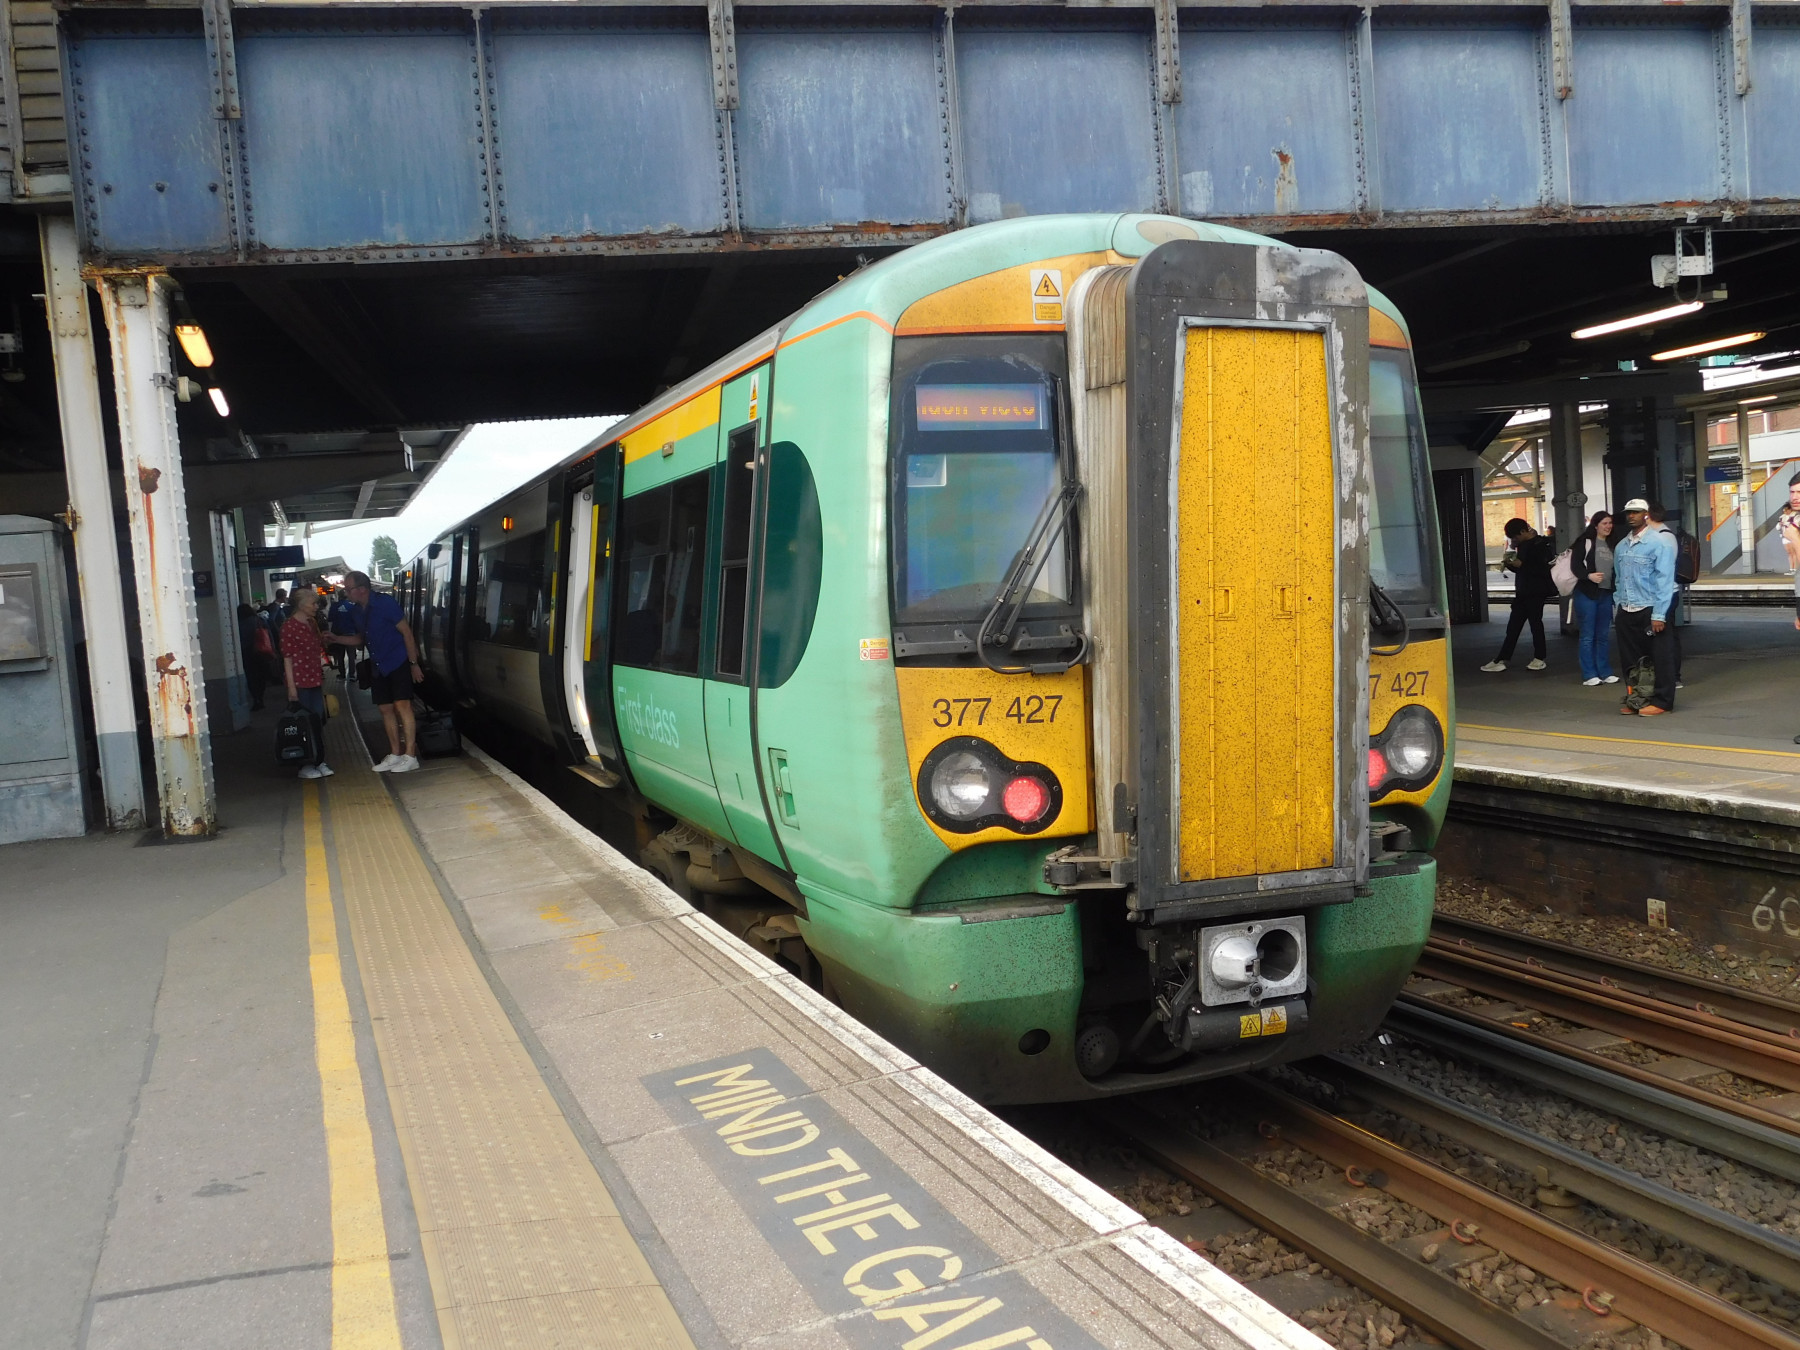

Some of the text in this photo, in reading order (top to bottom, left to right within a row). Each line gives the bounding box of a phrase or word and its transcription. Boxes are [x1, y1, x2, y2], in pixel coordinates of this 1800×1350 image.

[1391, 670, 1430, 698] 427
[617, 686, 680, 749] First class
[932, 694, 1064, 728] 377 427
[674, 1063, 821, 1157] MIND
[757, 1146, 922, 1256] THE
